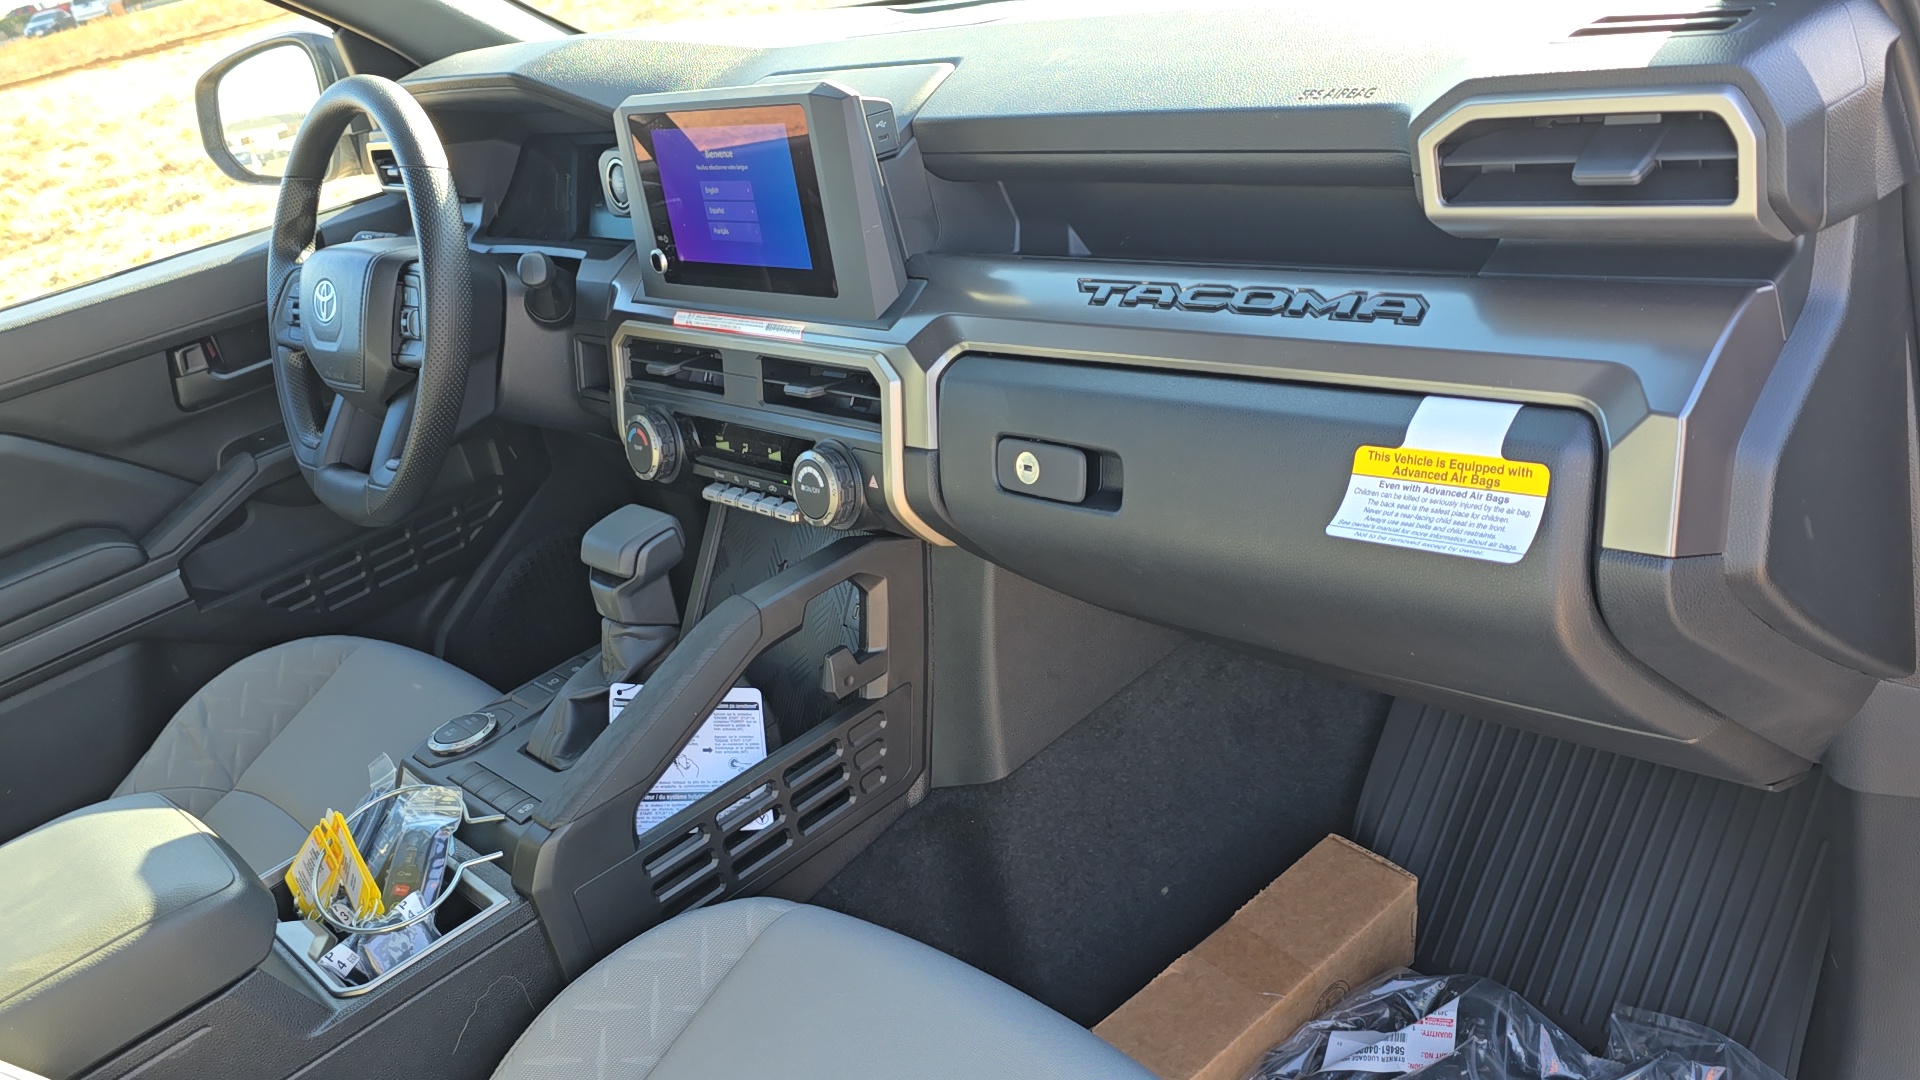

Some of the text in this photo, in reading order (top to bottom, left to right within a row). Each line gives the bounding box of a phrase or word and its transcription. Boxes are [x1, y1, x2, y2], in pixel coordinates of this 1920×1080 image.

[1322, 87, 1377, 99] AIRBAG
[1077, 277, 1430, 326] TACOMA
[1368, 450, 1533, 478] This Vehicle is Equipped with
[1392, 466, 1500, 488] Advanced Air Bags
[1354, 487, 1379, 497] Children
[1393, 492, 1402, 500] be
[1403, 493, 1420, 502] killed
[1428, 497, 1458, 508] seriously
[1460, 500, 1482, 510] injured
[1484, 504, 1492, 512] by
[1494, 505, 1504, 513] the
[1517, 509, 1532, 518] bag.
[1379, 480, 1510, 505] Even with Advanced Air Bags
[1363, 506, 1381, 514] Never
[1382, 509, 1393, 517] put
[1400, 512, 1434, 524] rear-facing
[1435, 516, 1452, 525] child
[1452, 519, 1467, 527] seat
[1468, 520, 1475, 528] in
[1476, 521, 1487, 530] the
[1489, 524, 1506, 532] front.
[1368, 498, 1379, 506] The
[1380, 500, 1395, 508] back
[1396, 502, 1410, 510] seat
[1419, 504, 1429, 512] the
[1430, 506, 1450, 516] safest
[1451, 510, 1469, 518] place
[1481, 513, 1509, 524] children.
[1364, 515, 1386, 524] Always
[1400, 520, 1414, 528] seat
[1416, 522, 1432, 530] belts
[1447, 526, 1462, 534] child
[1376, 524, 1400, 533] manual
[1429, 532, 1466, 542] information
[1467, 538, 1487, 546] about
[337, 960, 347, 969] 4
[1420, 1030, 1453, 1039] QUANTITY:
